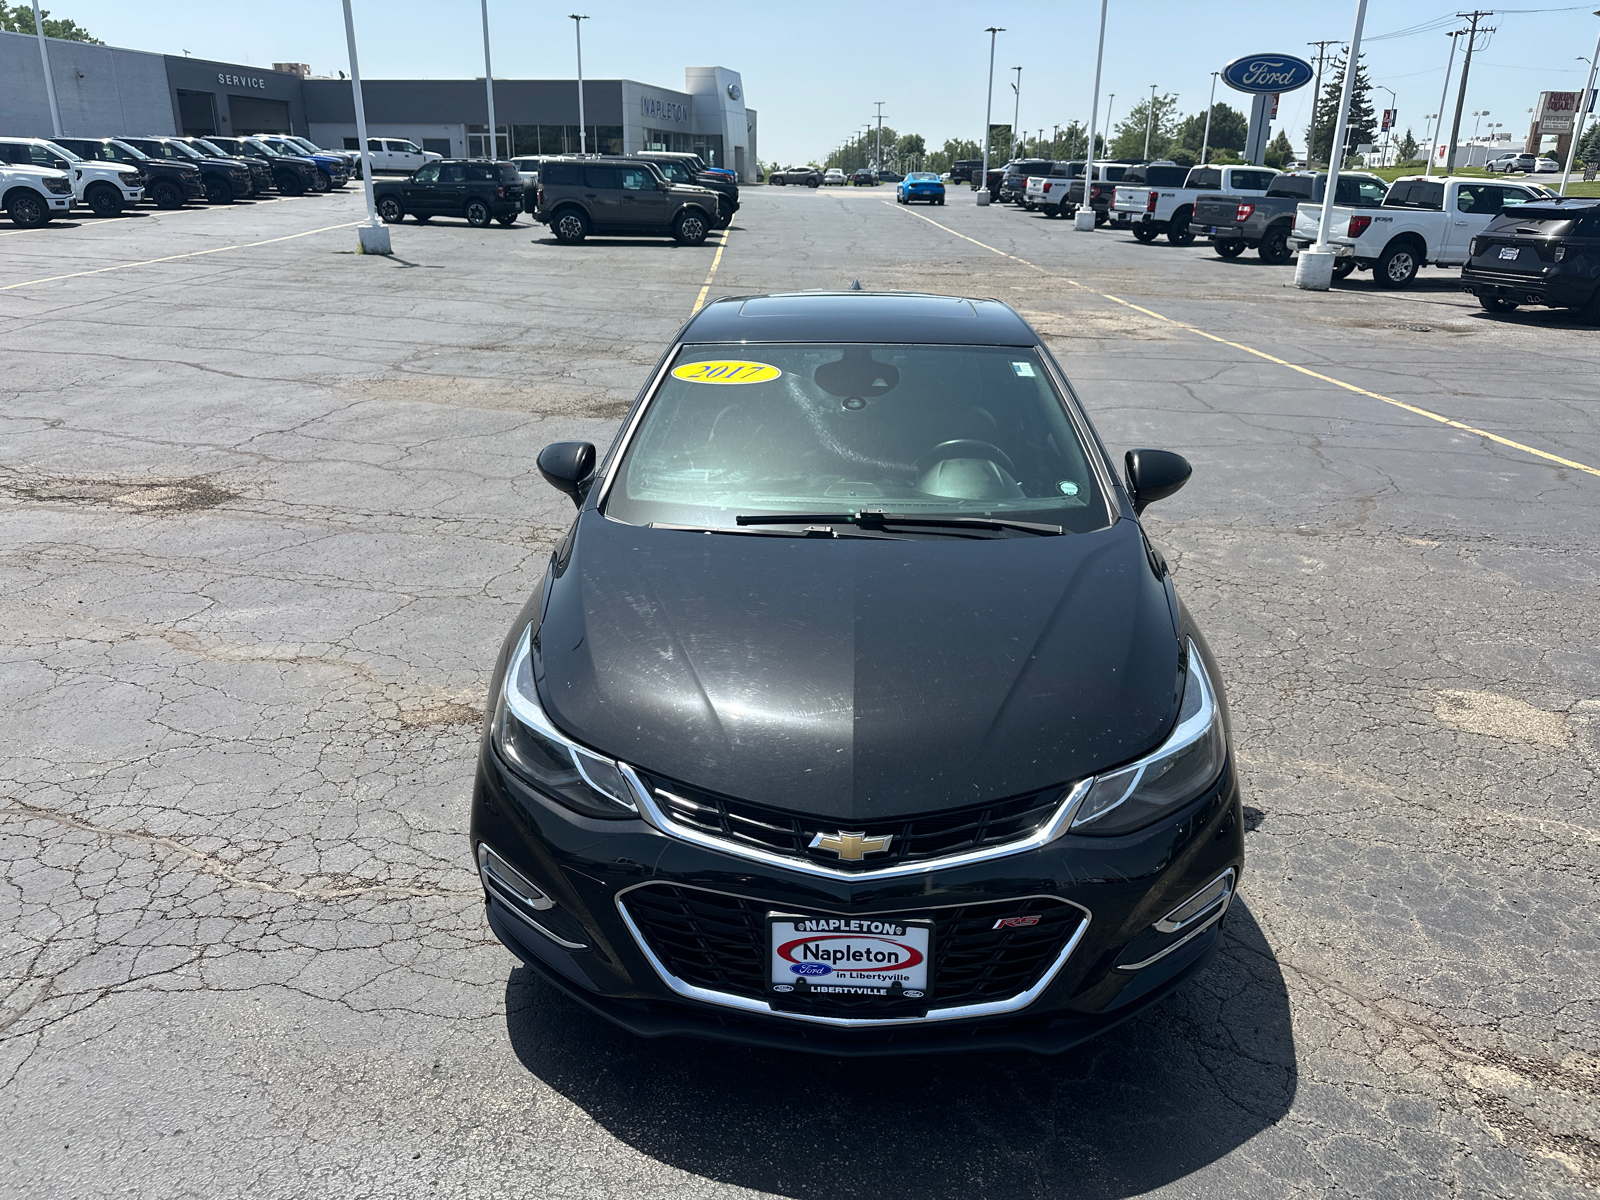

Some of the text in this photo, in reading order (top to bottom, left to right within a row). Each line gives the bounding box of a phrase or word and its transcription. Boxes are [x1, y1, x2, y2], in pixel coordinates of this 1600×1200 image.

[1242, 61, 1296, 84] Ford
[218, 73, 265, 89] SERVICE
[642, 97, 688, 121] NAPLETON
[686, 366, 766, 379] 2017
[805, 919, 896, 935] NAPLETON
[992, 915, 1042, 930] RS
[803, 944, 899, 966] Napleton
[798, 964, 825, 975] Ford
[850, 972, 910, 982] Libertyville
[811, 986, 887, 996] LIBERTYVILLE
